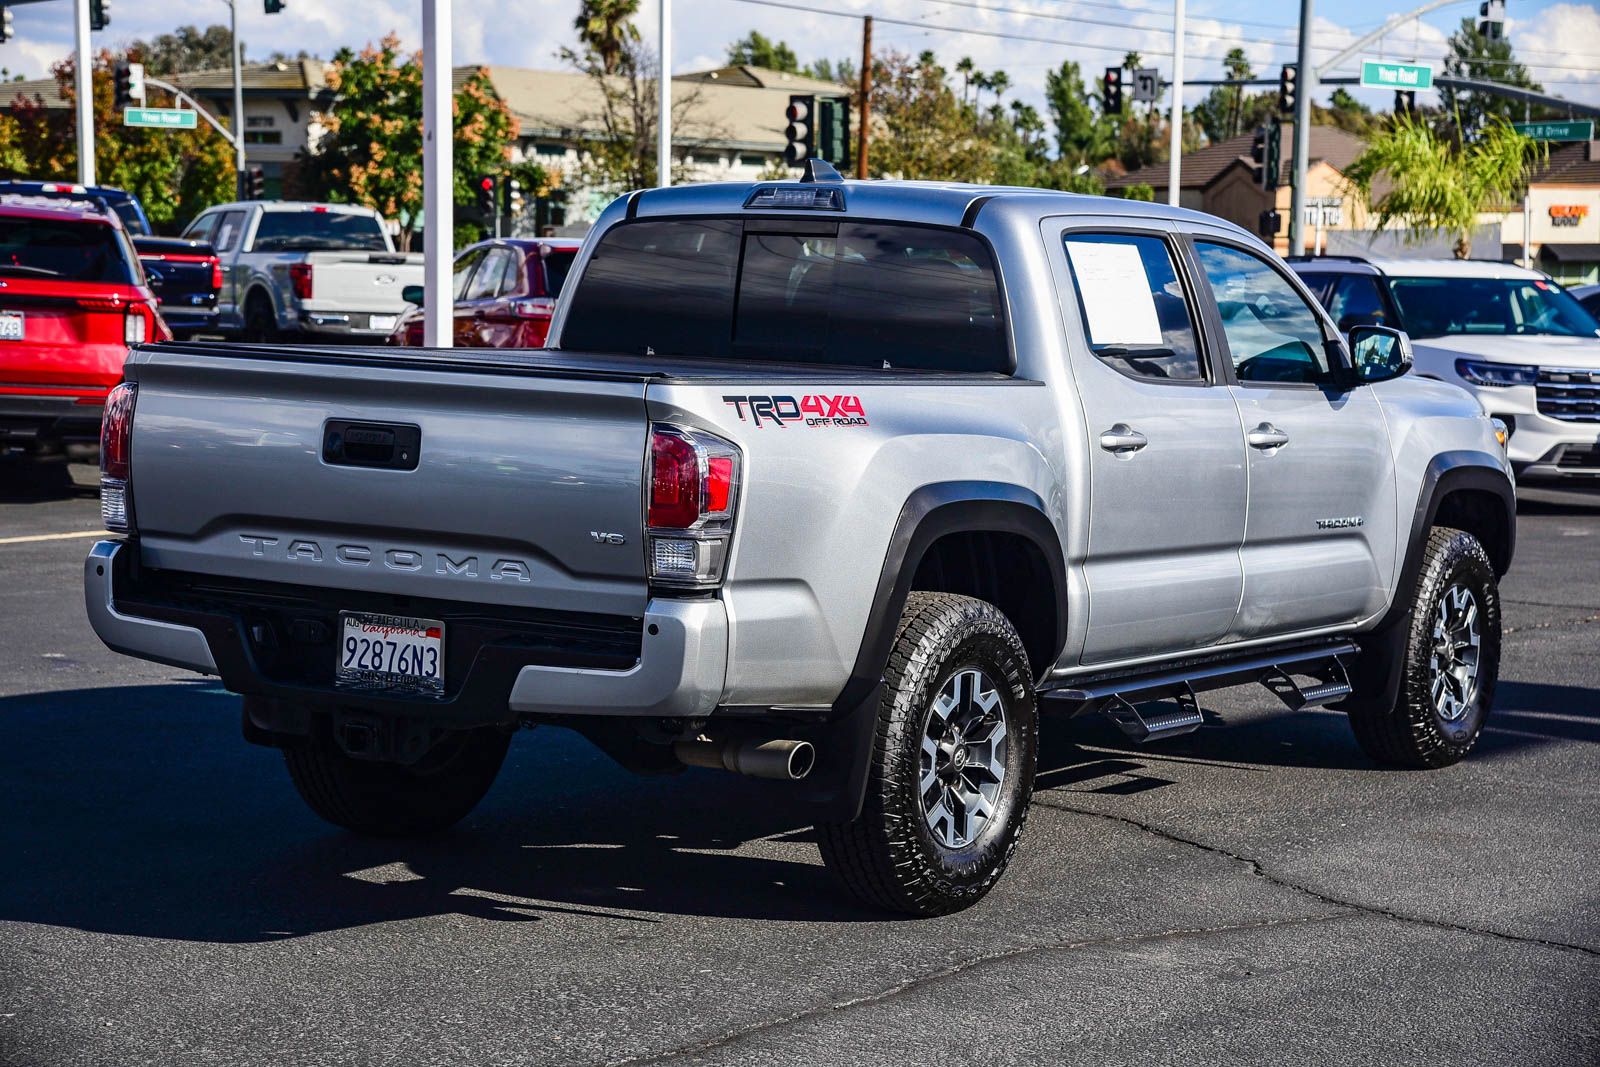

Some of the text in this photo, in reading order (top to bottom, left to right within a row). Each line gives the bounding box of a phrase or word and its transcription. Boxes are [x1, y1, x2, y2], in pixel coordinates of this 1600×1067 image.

[722, 395, 802, 428] TRD
[806, 417, 868, 427] OFF ROAD
[590, 530, 625, 546] V6
[239, 533, 531, 582] TACOMA
[343, 636, 438, 678] 92876N3
